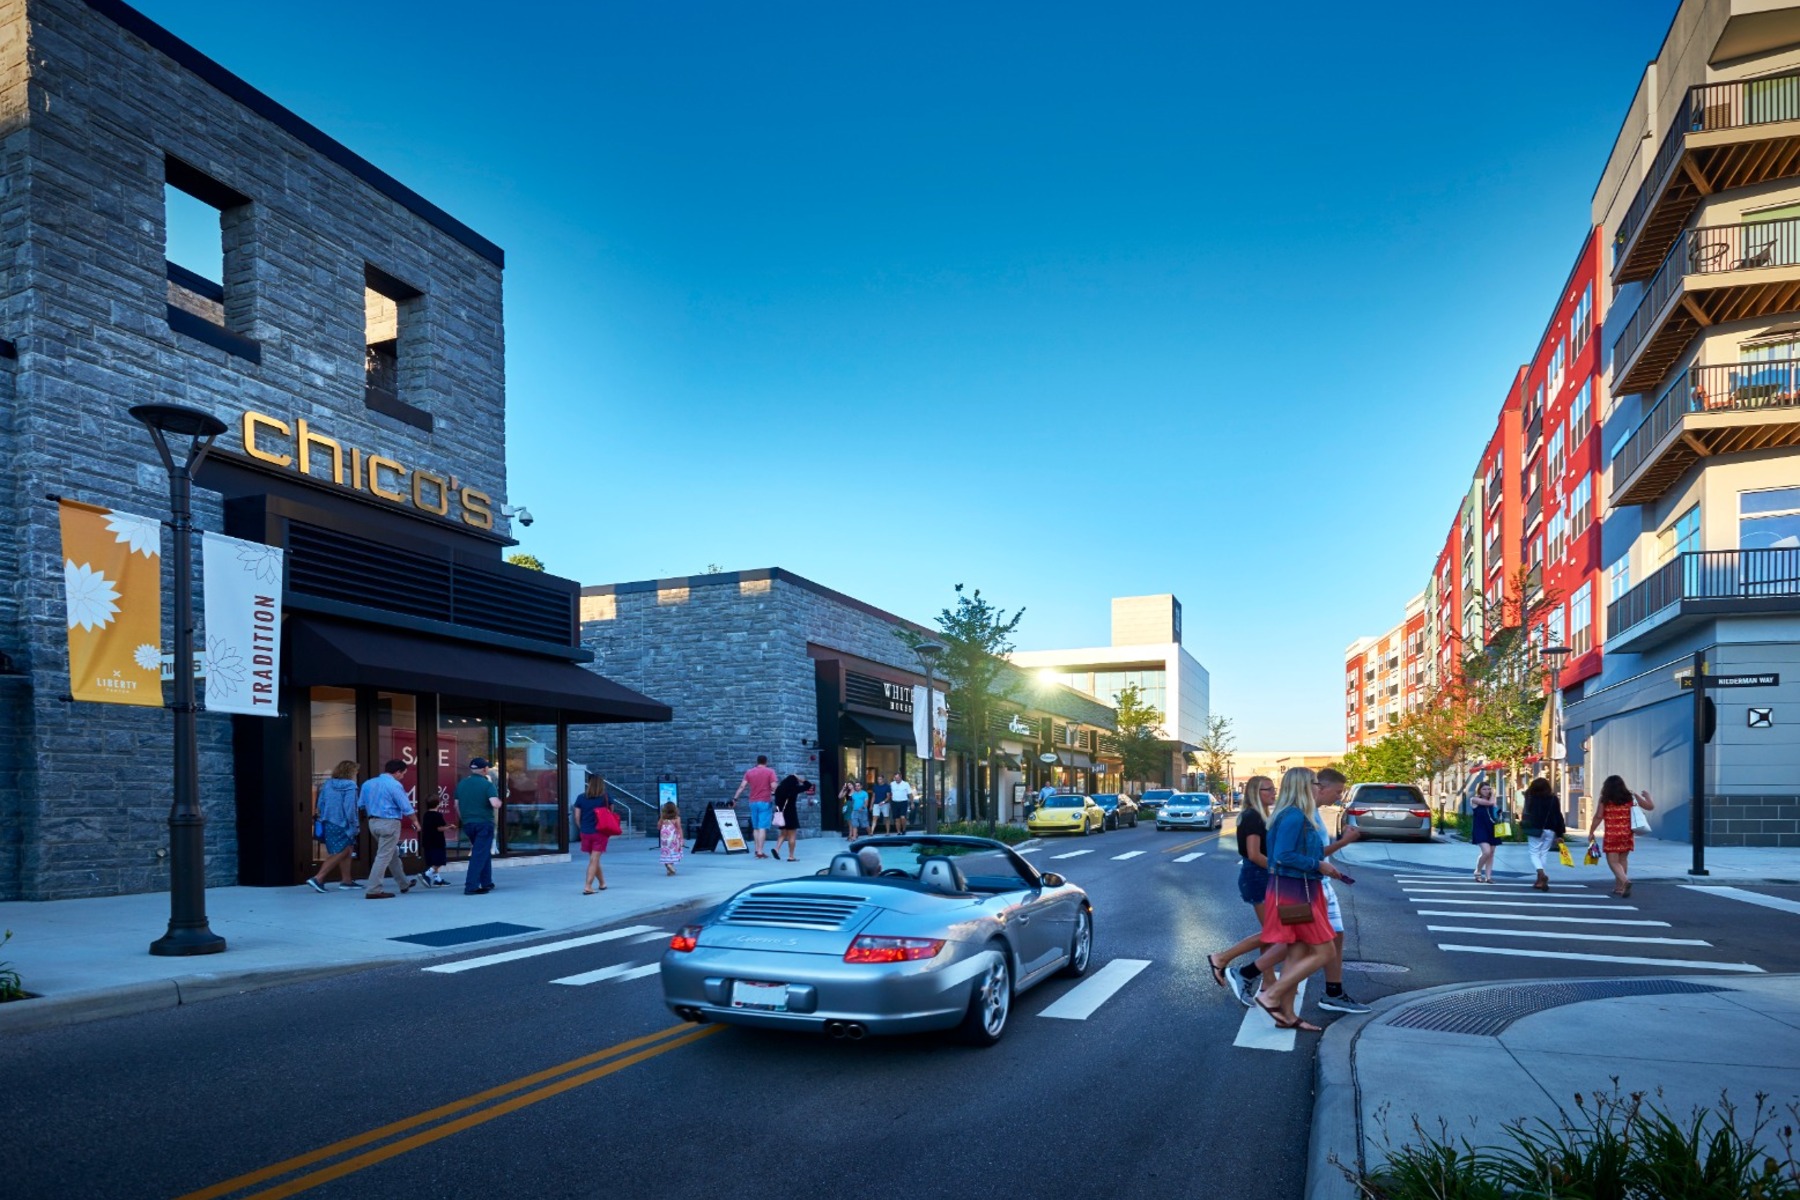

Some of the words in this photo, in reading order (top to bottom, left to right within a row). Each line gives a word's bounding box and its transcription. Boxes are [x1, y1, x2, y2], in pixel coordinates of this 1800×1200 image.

[252, 595, 275, 705] TRADITION
[96, 677, 137, 689] LIBERTY
[1759, 676, 1774, 684] WAY
[402, 746, 450, 767] SE
[396, 839, 418, 854] 40
